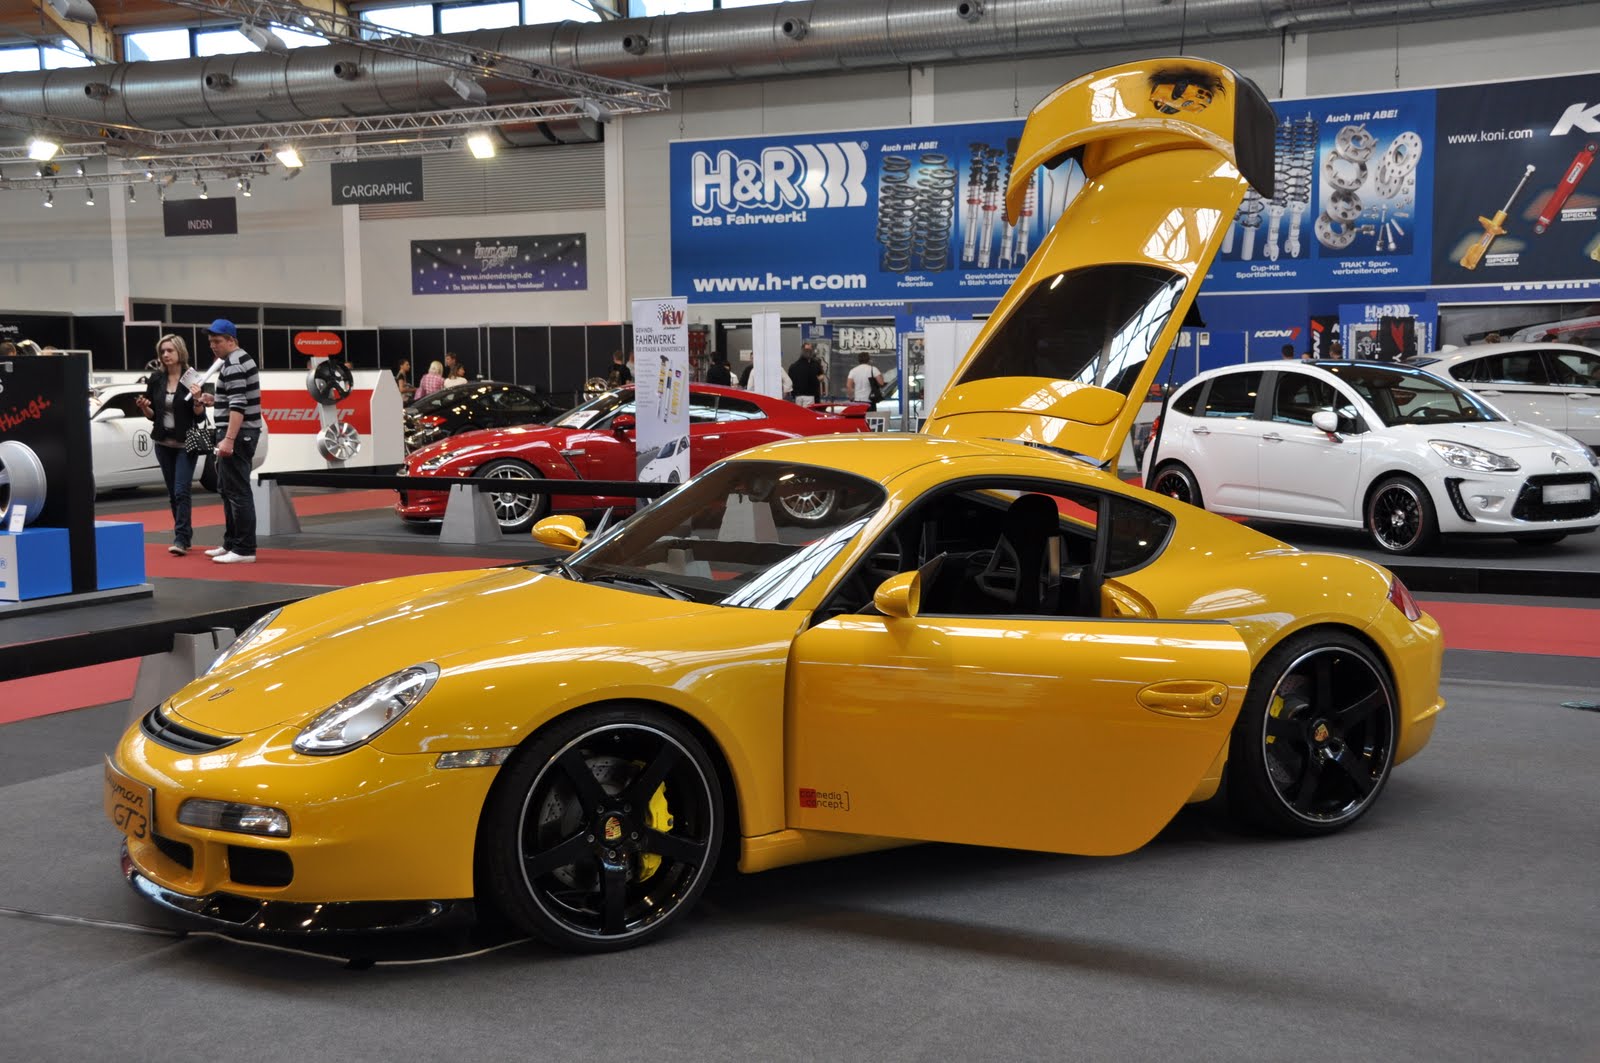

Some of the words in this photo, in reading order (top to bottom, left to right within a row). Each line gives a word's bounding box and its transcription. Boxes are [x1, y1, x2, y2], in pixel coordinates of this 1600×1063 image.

[1325, 113, 1351, 123] Auch
[1353, 111, 1370, 121] mit
[1372, 109, 1398, 119] ABE!
[1447, 128, 1533, 144] www.koni.com
[881, 144, 901, 152] Auch
[903, 142, 917, 151] mit
[918, 141, 938, 150] ABE!
[692, 146, 806, 213] H&R
[342, 181, 413, 198] CARGRAPHIC
[187, 219, 213, 230] INDEN
[692, 215, 722, 226] Das
[726, 211, 806, 226] Fahrwerk!
[1250, 265, 1280, 273] Cup-Kit
[1332, 266, 1399, 275] verbreiterungen
[1368, 261, 1391, 269] Spur-
[461, 271, 533, 281] www.indendesign.de
[693, 272, 867, 292] www.h-r.com
[662, 311, 685, 325] KW
[635, 334, 677, 345] FAHRWERKE
[839, 327, 880, 349] H&R
[1254, 330, 1292, 338] KONI
[113, 803, 147, 838] GT3
